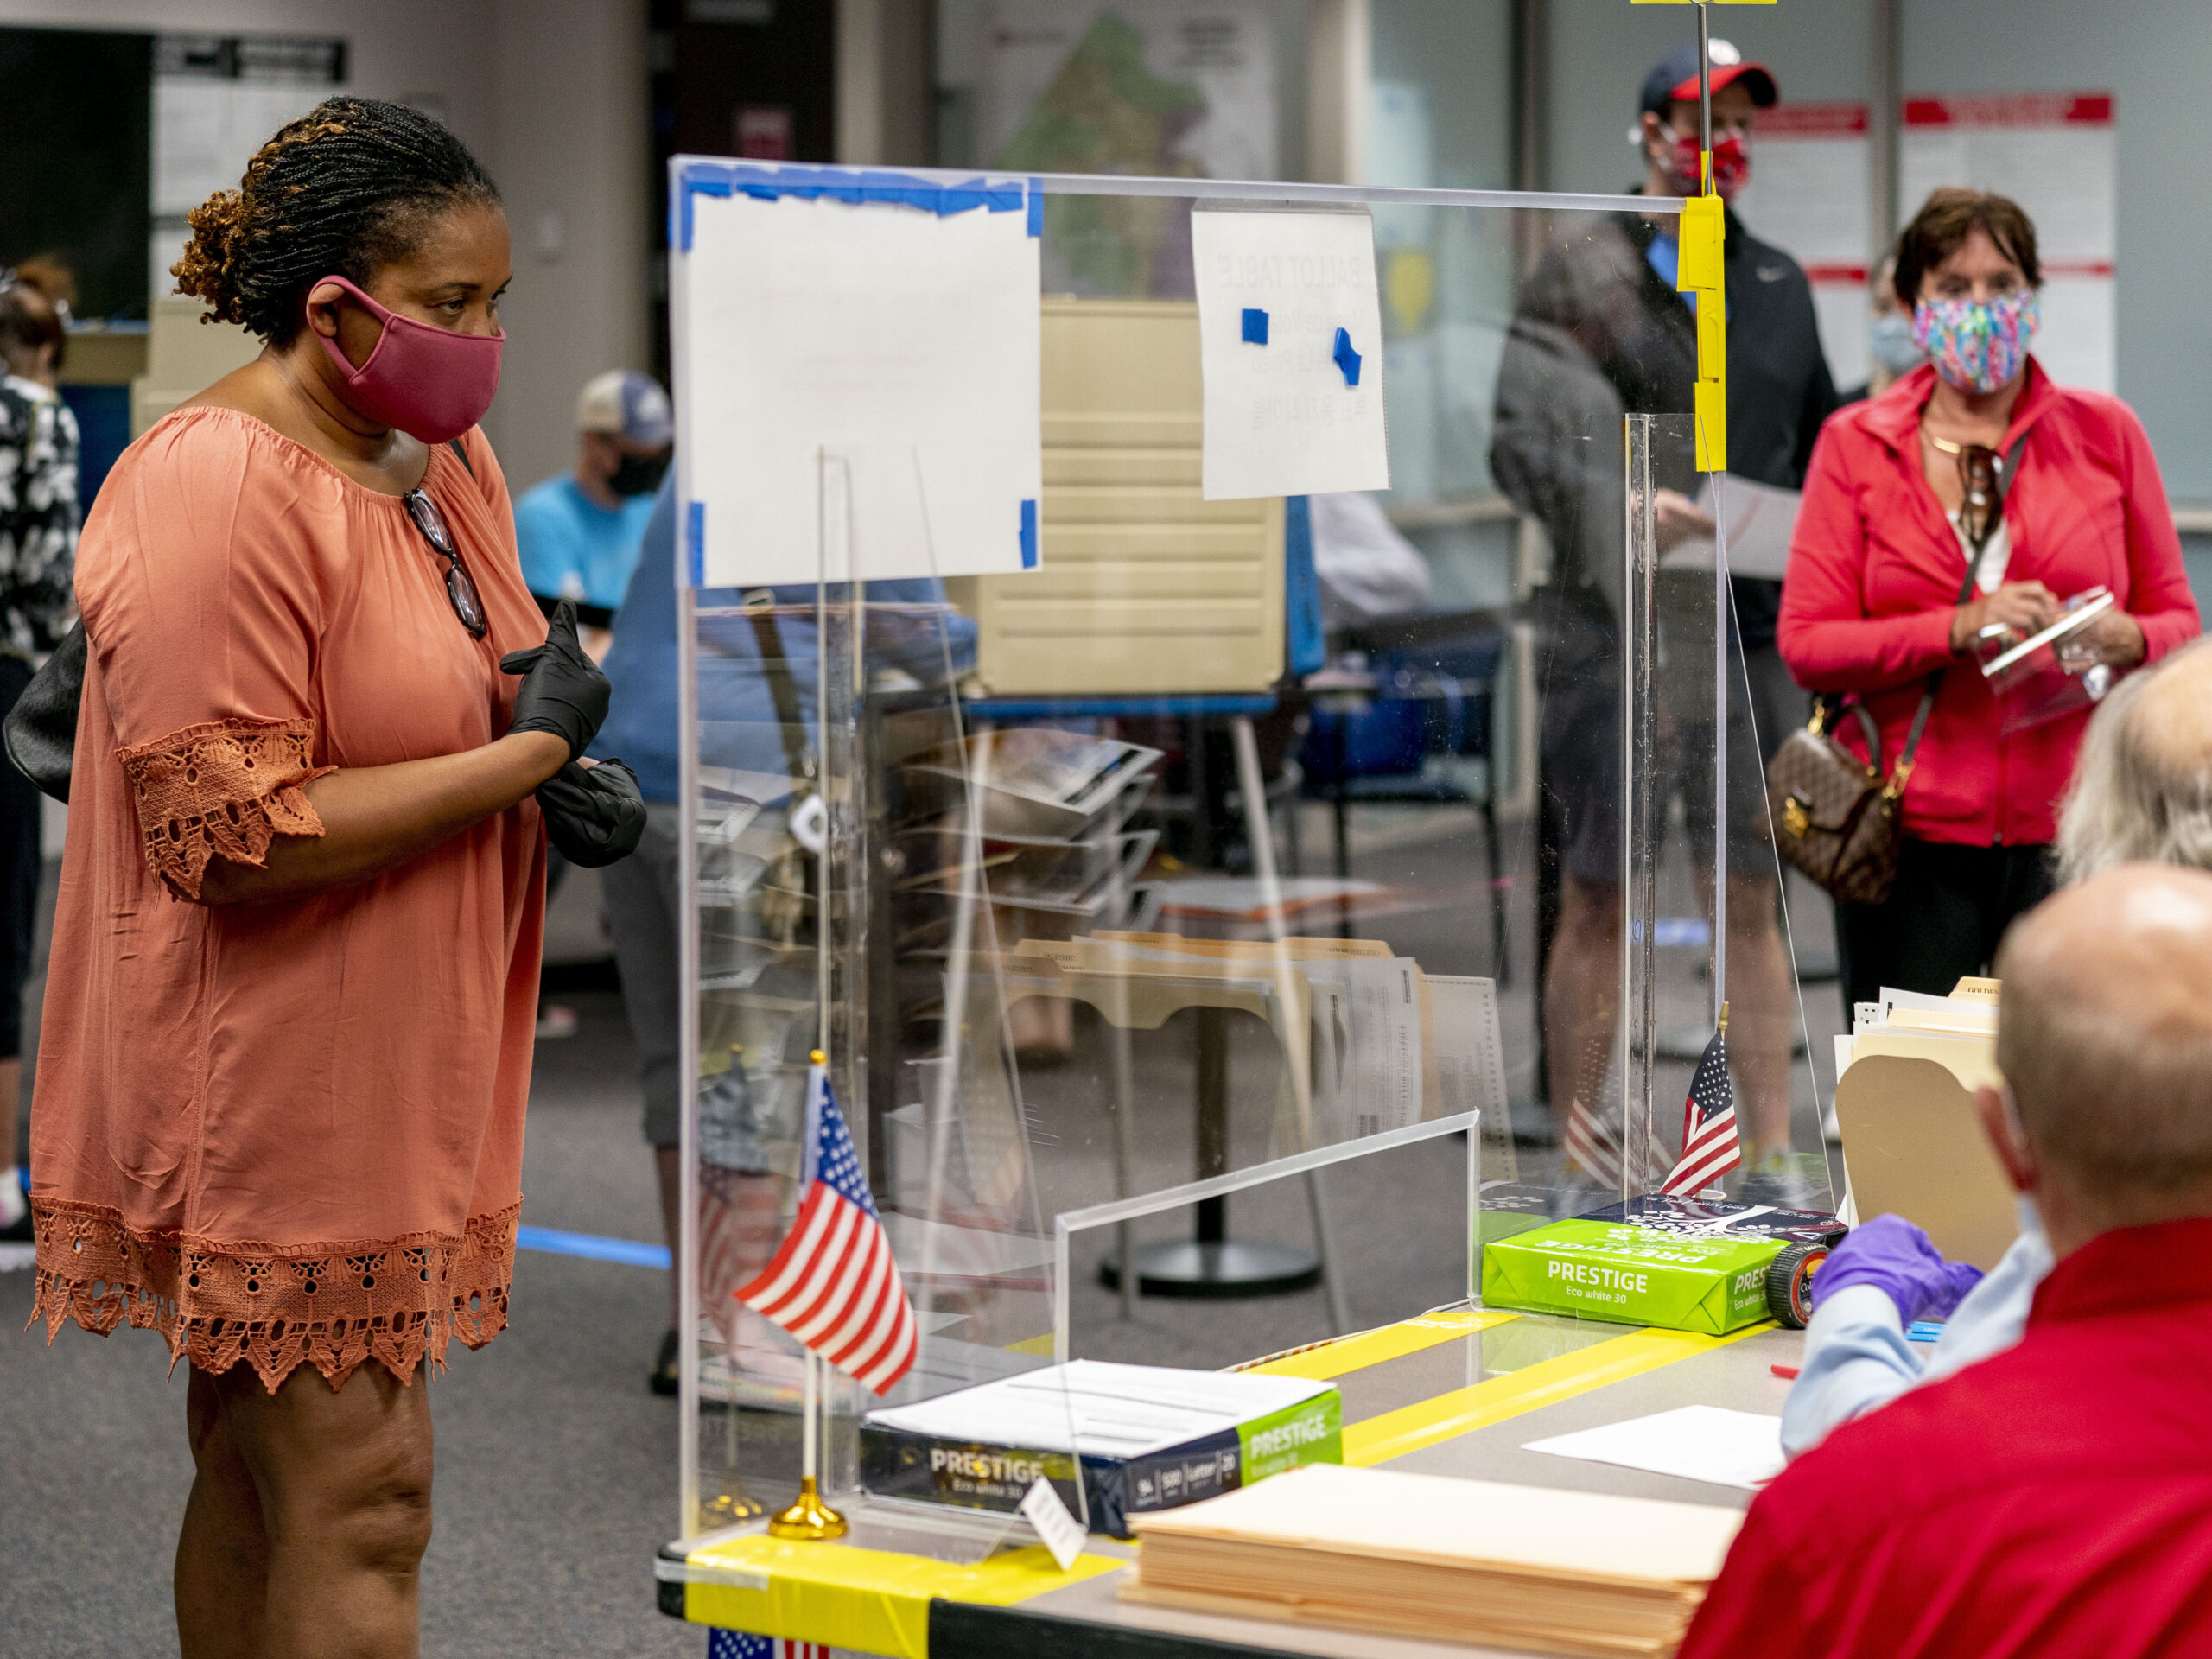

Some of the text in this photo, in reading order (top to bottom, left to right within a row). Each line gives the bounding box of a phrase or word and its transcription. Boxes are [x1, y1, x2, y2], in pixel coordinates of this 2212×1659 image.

[1535, 1239, 1708, 1264] PRESTIGE
[1548, 1259, 1649, 1294] PRESTIGE
[1733, 1264, 1771, 1295] PRES
[1566, 1285, 1627, 1304] Eco white 30
[1734, 1298, 1744, 1311] Eco
[1745, 1294, 1760, 1306] white
[1250, 1414, 1328, 1459] PRESTIGE
[952, 1477, 975, 1493] Eco
